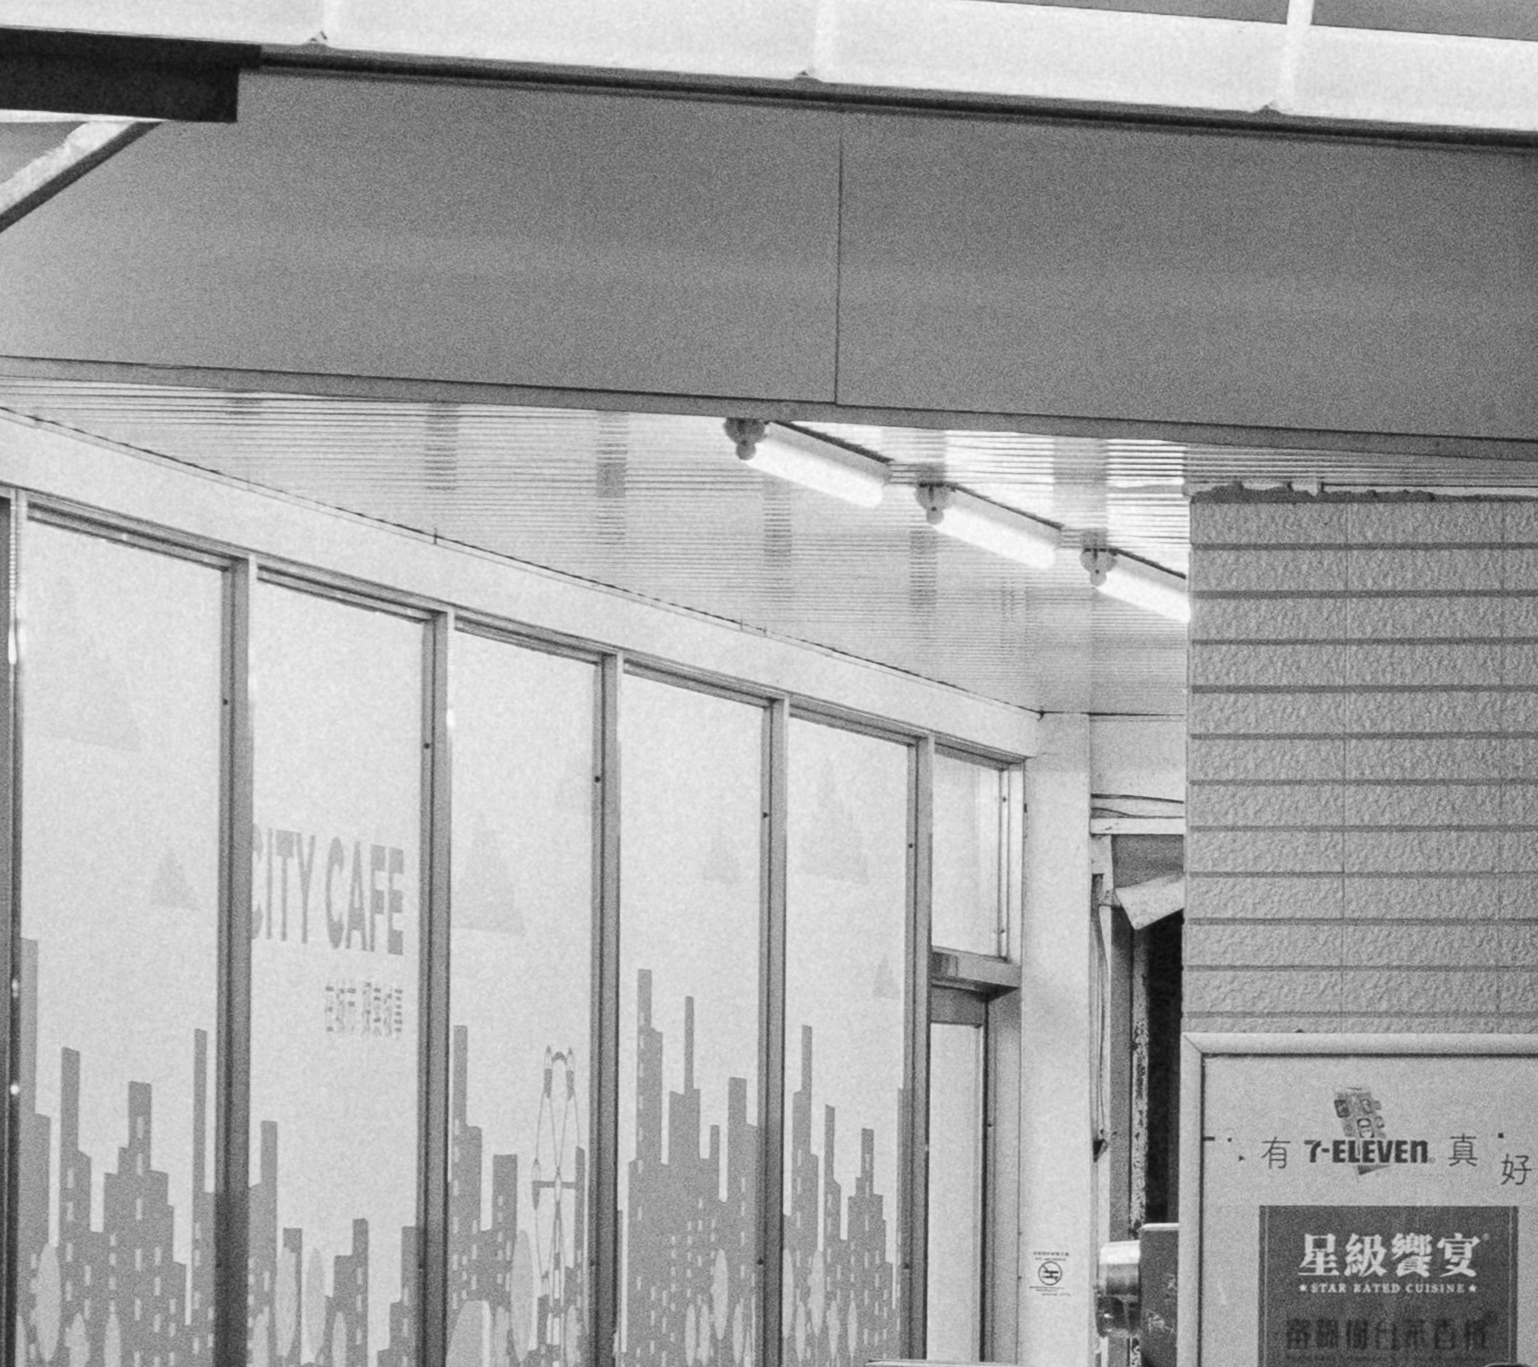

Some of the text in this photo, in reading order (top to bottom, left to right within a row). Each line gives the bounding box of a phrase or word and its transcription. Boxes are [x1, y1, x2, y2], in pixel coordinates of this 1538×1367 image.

[325, 836, 405, 957] CAFE
[1261, 1136, 1292, 1170] 有
[1298, 1232, 1481, 1278] 星級饗宴
[1406, 1282, 1465, 1294] CUISINE
